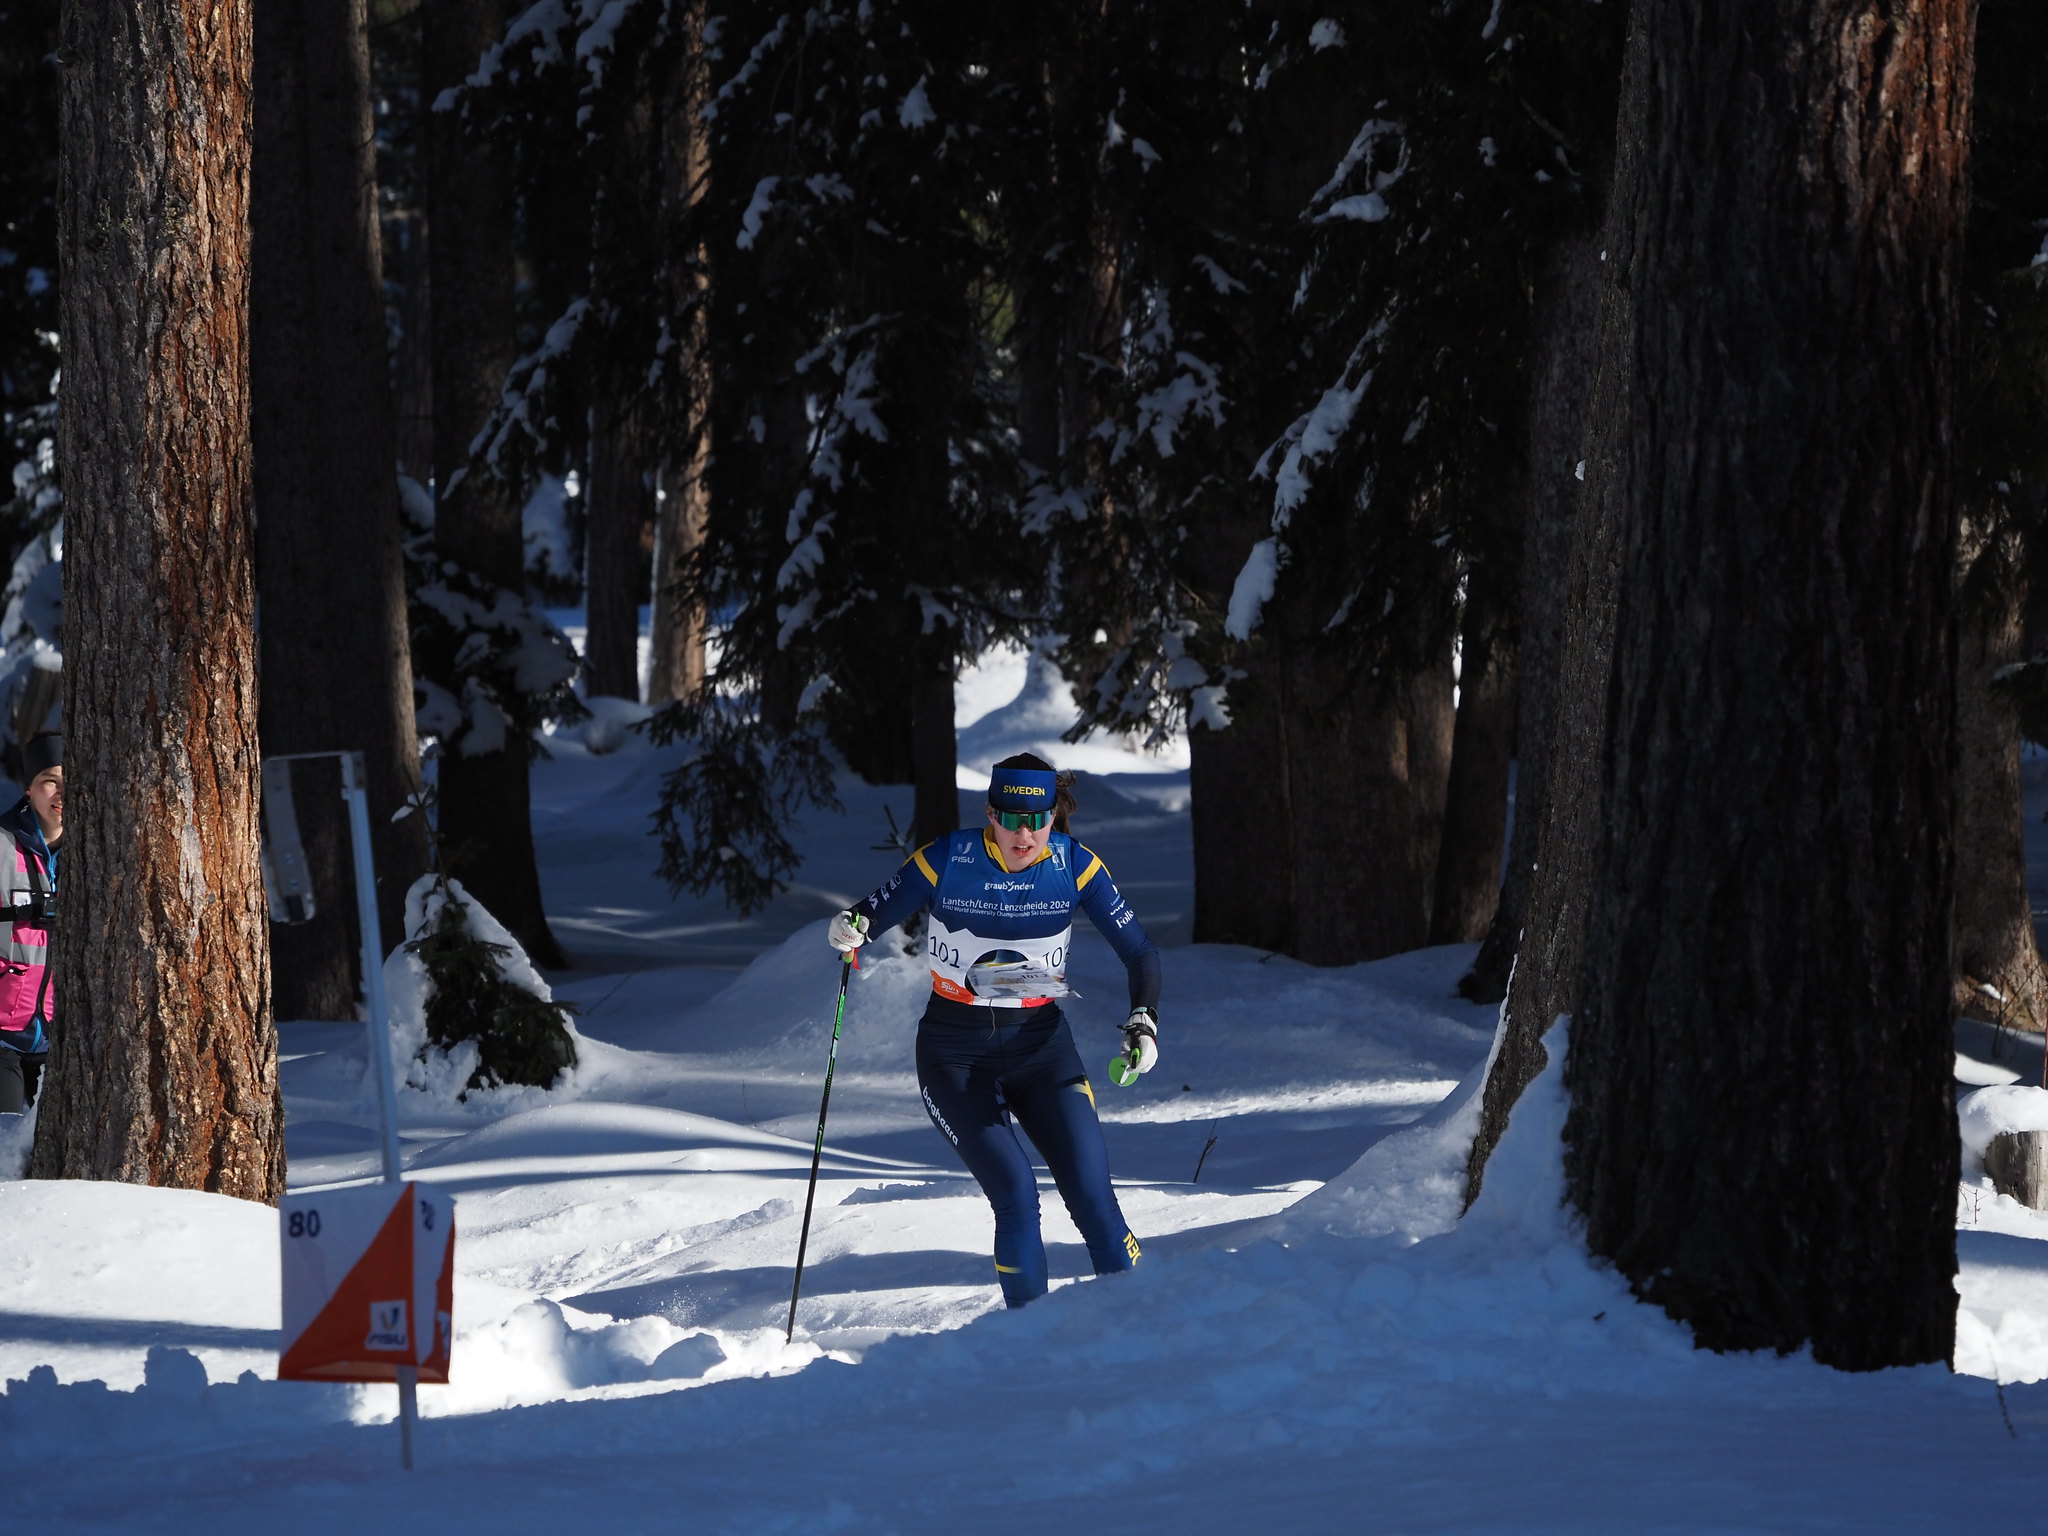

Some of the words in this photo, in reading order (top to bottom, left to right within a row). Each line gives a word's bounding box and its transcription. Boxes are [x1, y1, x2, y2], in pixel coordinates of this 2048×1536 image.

[1003, 785, 1046, 796] SWEDEN
[951, 856, 975, 864] FISU
[942, 897, 999, 910] Lantsch/Lenz
[1000, 901, 1049, 912] Lenzerheide
[1050, 900, 1070, 910] 2024
[954, 905, 970, 913] World
[970, 908, 996, 917] University
[929, 935, 961, 969] 101
[922, 1086, 959, 1146] bagheera
[288, 1209, 322, 1238] 80
